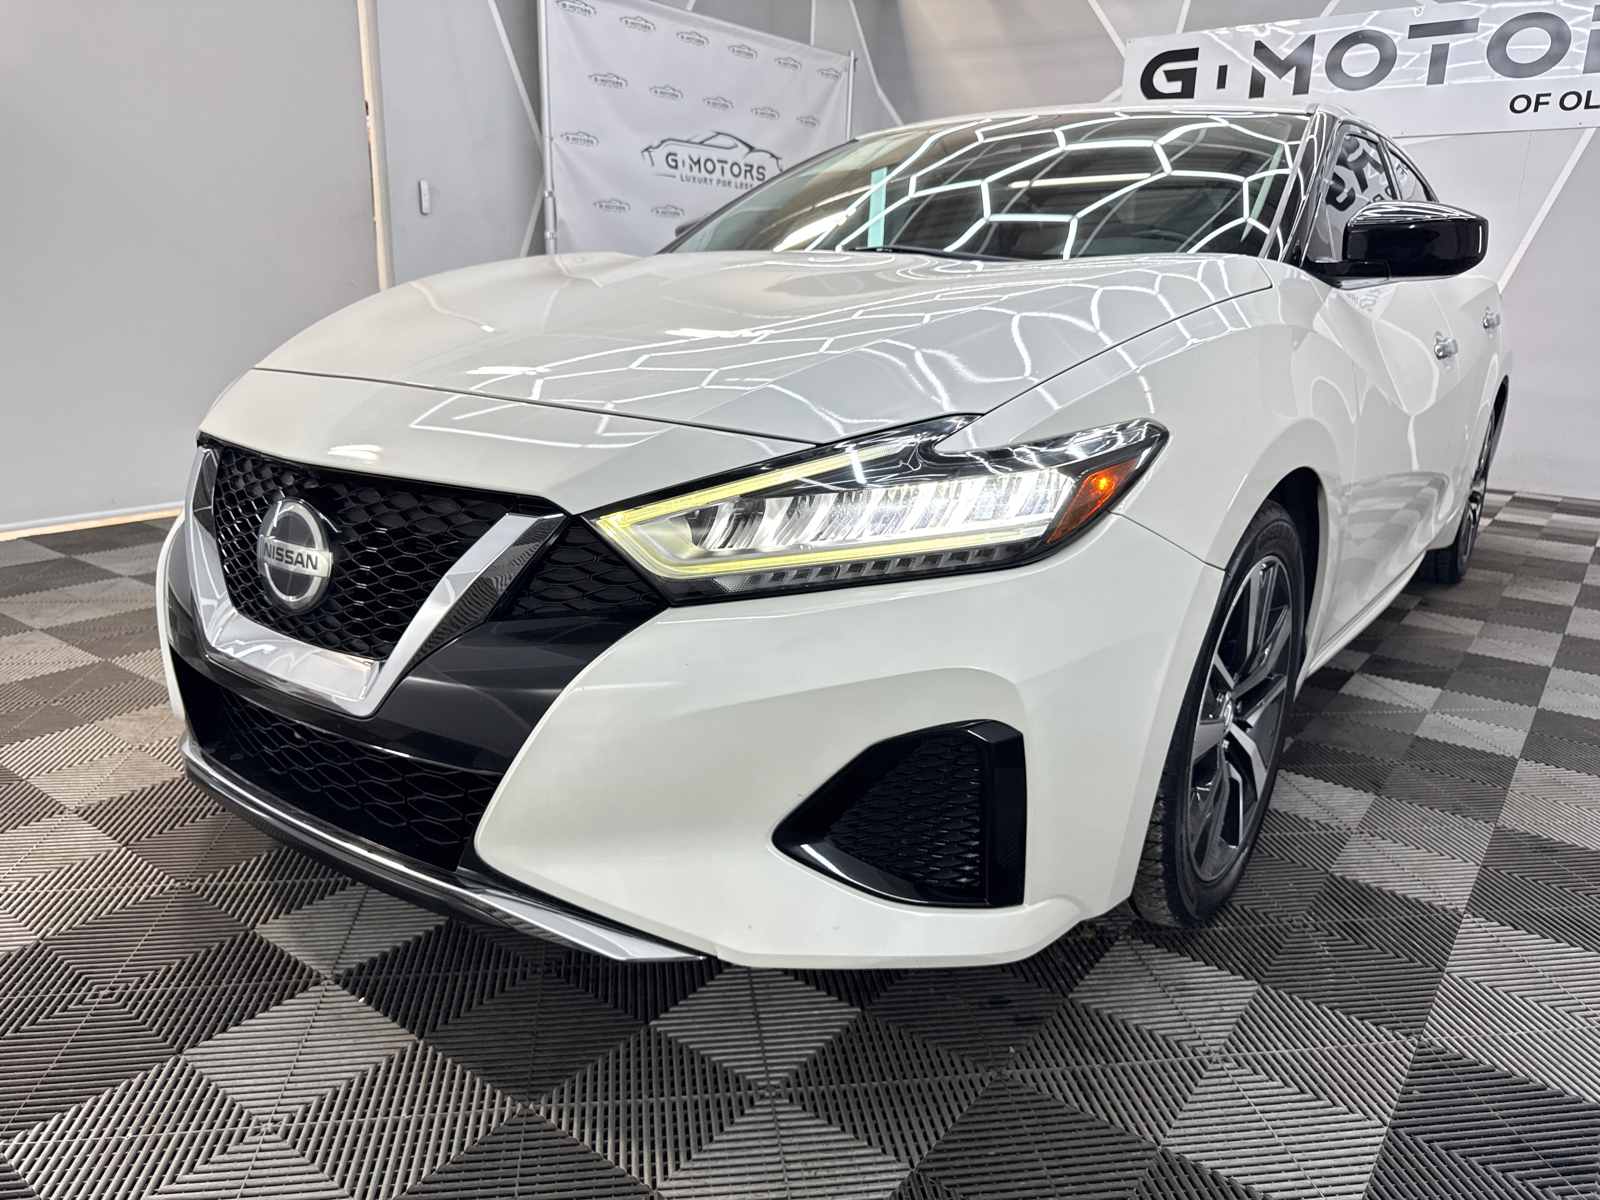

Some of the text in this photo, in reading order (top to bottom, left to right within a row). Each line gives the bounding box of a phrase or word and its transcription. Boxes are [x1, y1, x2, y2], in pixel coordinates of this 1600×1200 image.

[1509, 90, 1600, 113] OF OL
[680, 174, 714, 186] LUXURY
[717, 178, 732, 188] FOR
[265, 541, 318, 570] NISSAN
